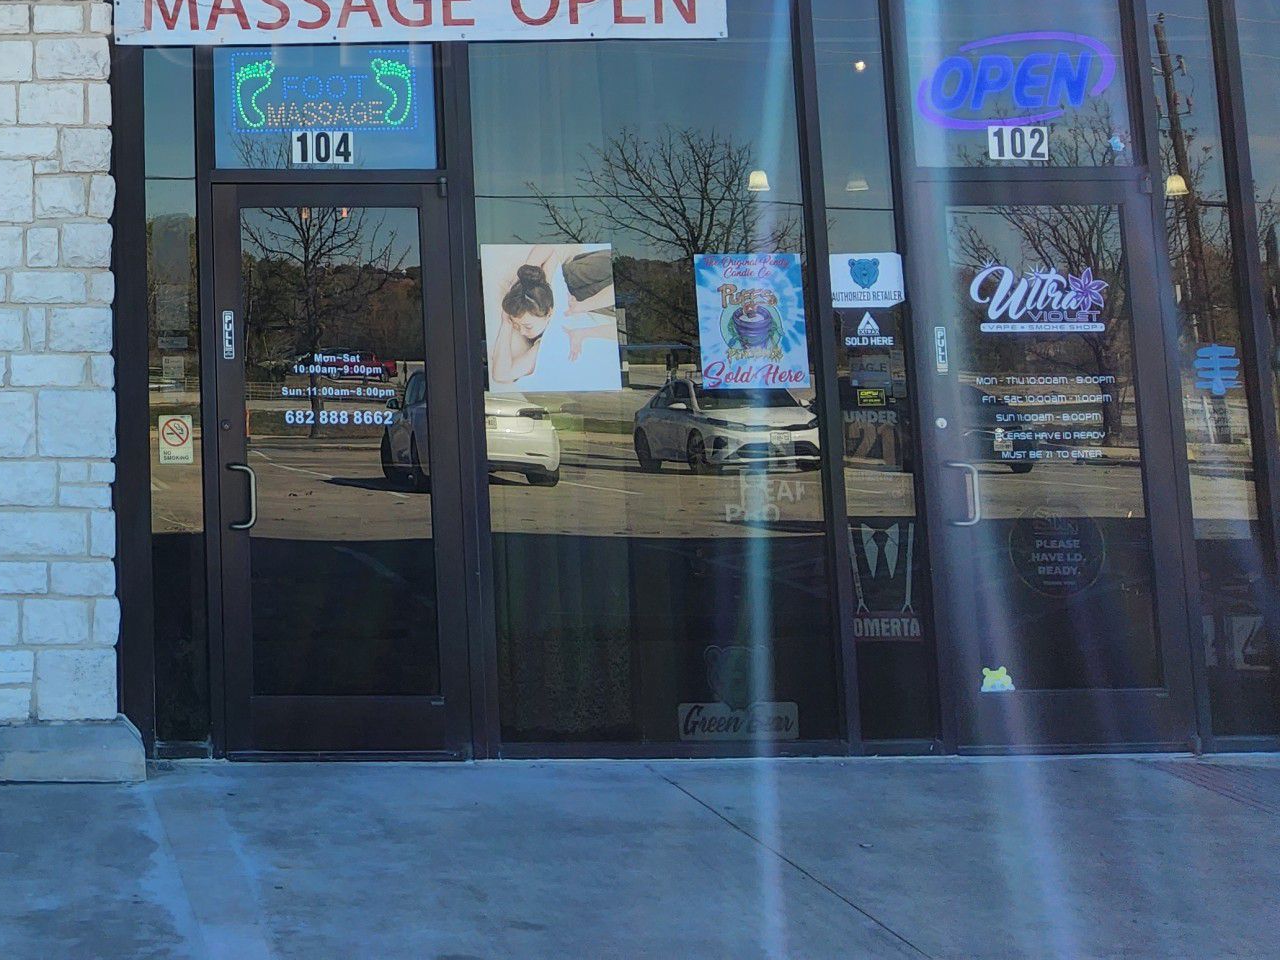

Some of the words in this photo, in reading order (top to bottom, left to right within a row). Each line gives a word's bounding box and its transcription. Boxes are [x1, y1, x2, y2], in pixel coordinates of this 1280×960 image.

[282, 75, 368, 98] FOOT
[931, 51, 1093, 112] OPEN
[267, 101, 384, 126] MASSAGE
[296, 132, 351, 162] 104
[993, 127, 1045, 158] 102
[832, 291, 870, 301] AUTHORIZED
[872, 290, 903, 300] RETAILER
[970, 266, 1085, 320] Ultra
[1027, 311, 1101, 322] VIOLET
[225, 315, 233, 347] PULL
[845, 336, 869, 346] SOLD
[871, 336, 894, 346] HERE
[936, 331, 946, 363] PULL
[704, 361, 752, 387] Sold
[755, 364, 805, 385] Here
[285, 410, 315, 424] 682
[319, 410, 349, 424] 888
[353, 410, 393, 424] 8662
[844, 410, 897, 424] UNDER
[844, 422, 896, 465] 21
[1002, 450, 1026, 458] MUST
[1030, 450, 1042, 458] BE
[1056, 450, 1068, 458] TO
[1071, 449, 1102, 458] ENTER
[1035, 539, 1080, 549] PLEASE
[1031, 552, 1064, 562] HAVE
[853, 618, 920, 637] OMERTA
[684, 704, 742, 736] Green
